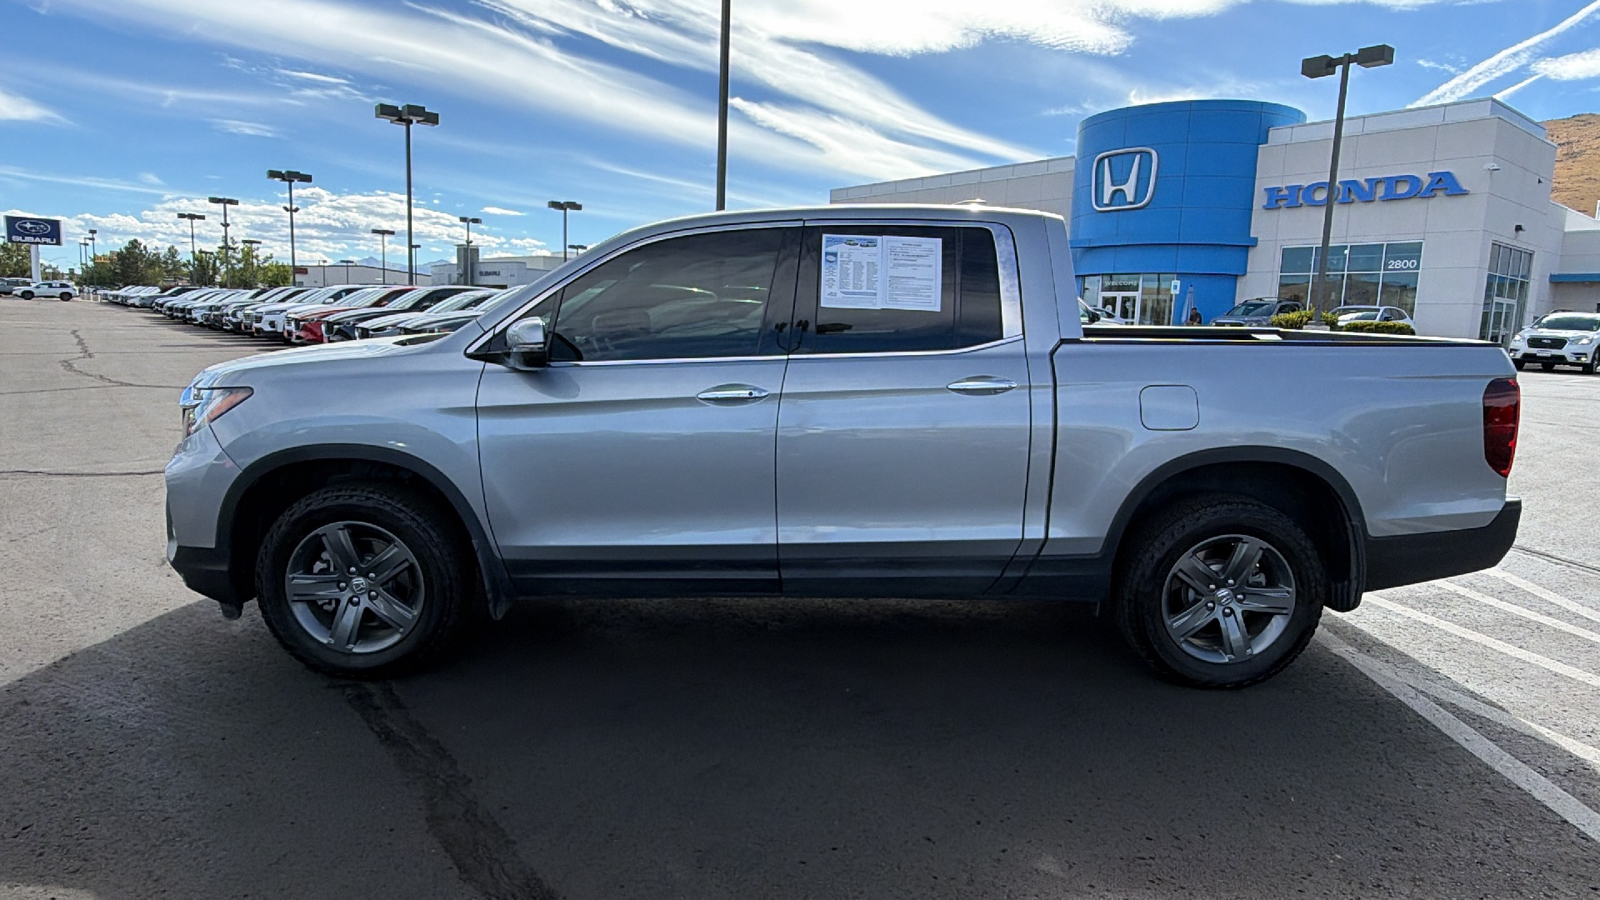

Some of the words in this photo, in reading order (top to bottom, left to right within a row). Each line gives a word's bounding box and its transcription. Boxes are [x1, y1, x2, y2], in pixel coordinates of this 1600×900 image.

[1262, 171, 1470, 209] HONDA
[12, 235, 56, 243] SUBARU
[1388, 260, 1417, 268] 2800
